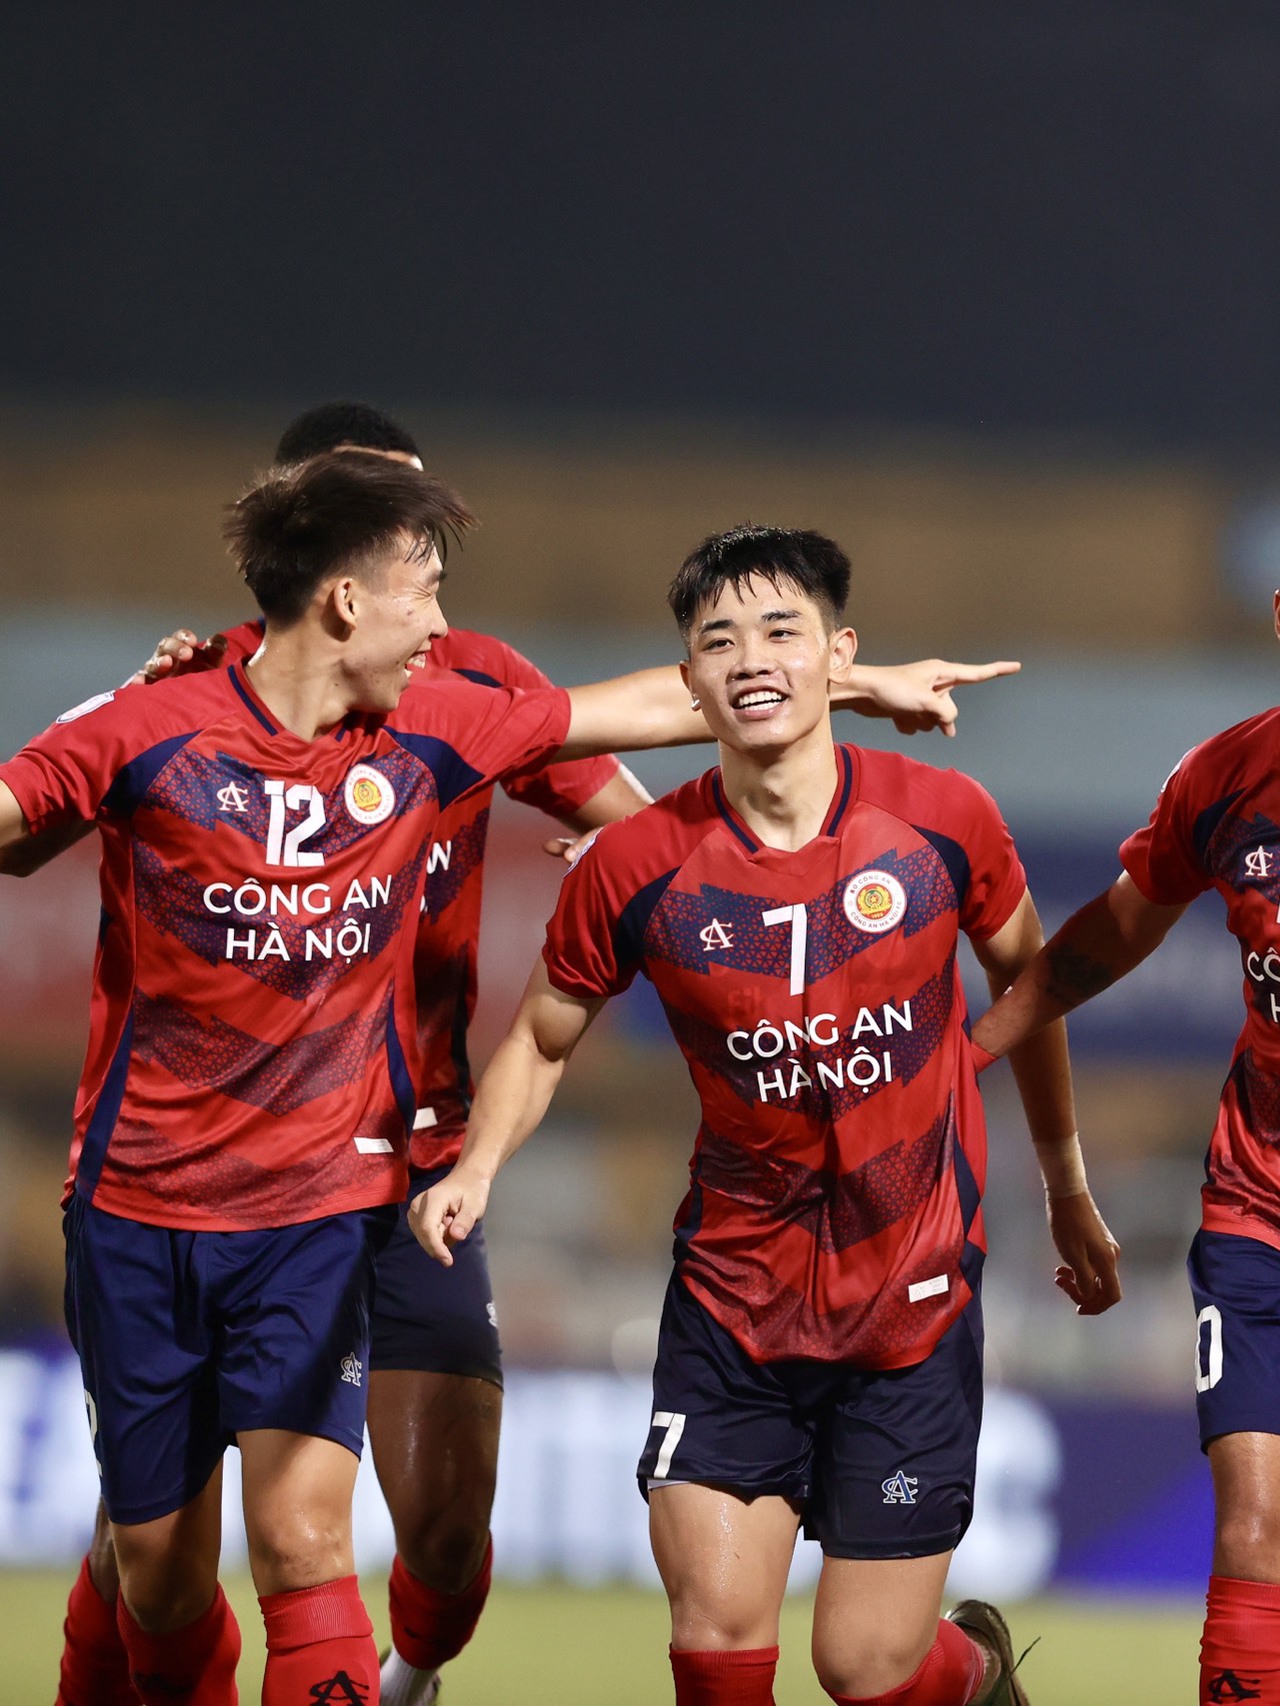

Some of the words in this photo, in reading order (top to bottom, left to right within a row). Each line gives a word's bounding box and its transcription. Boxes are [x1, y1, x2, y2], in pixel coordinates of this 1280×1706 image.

[264, 780, 326, 867] 12
[203, 877, 331, 915] CÔNG
[342, 874, 392, 912] AN
[226, 922, 290, 961] HÀ
[305, 918, 371, 964] NỘI
[761, 903, 808, 996] 7
[726, 1013, 840, 1061] CÔNG
[851, 1000, 913, 1040] AN
[756, 1058, 813, 1102] HÀ
[816, 1046, 893, 1094] NỘI
[652, 1411, 686, 1478] 7
